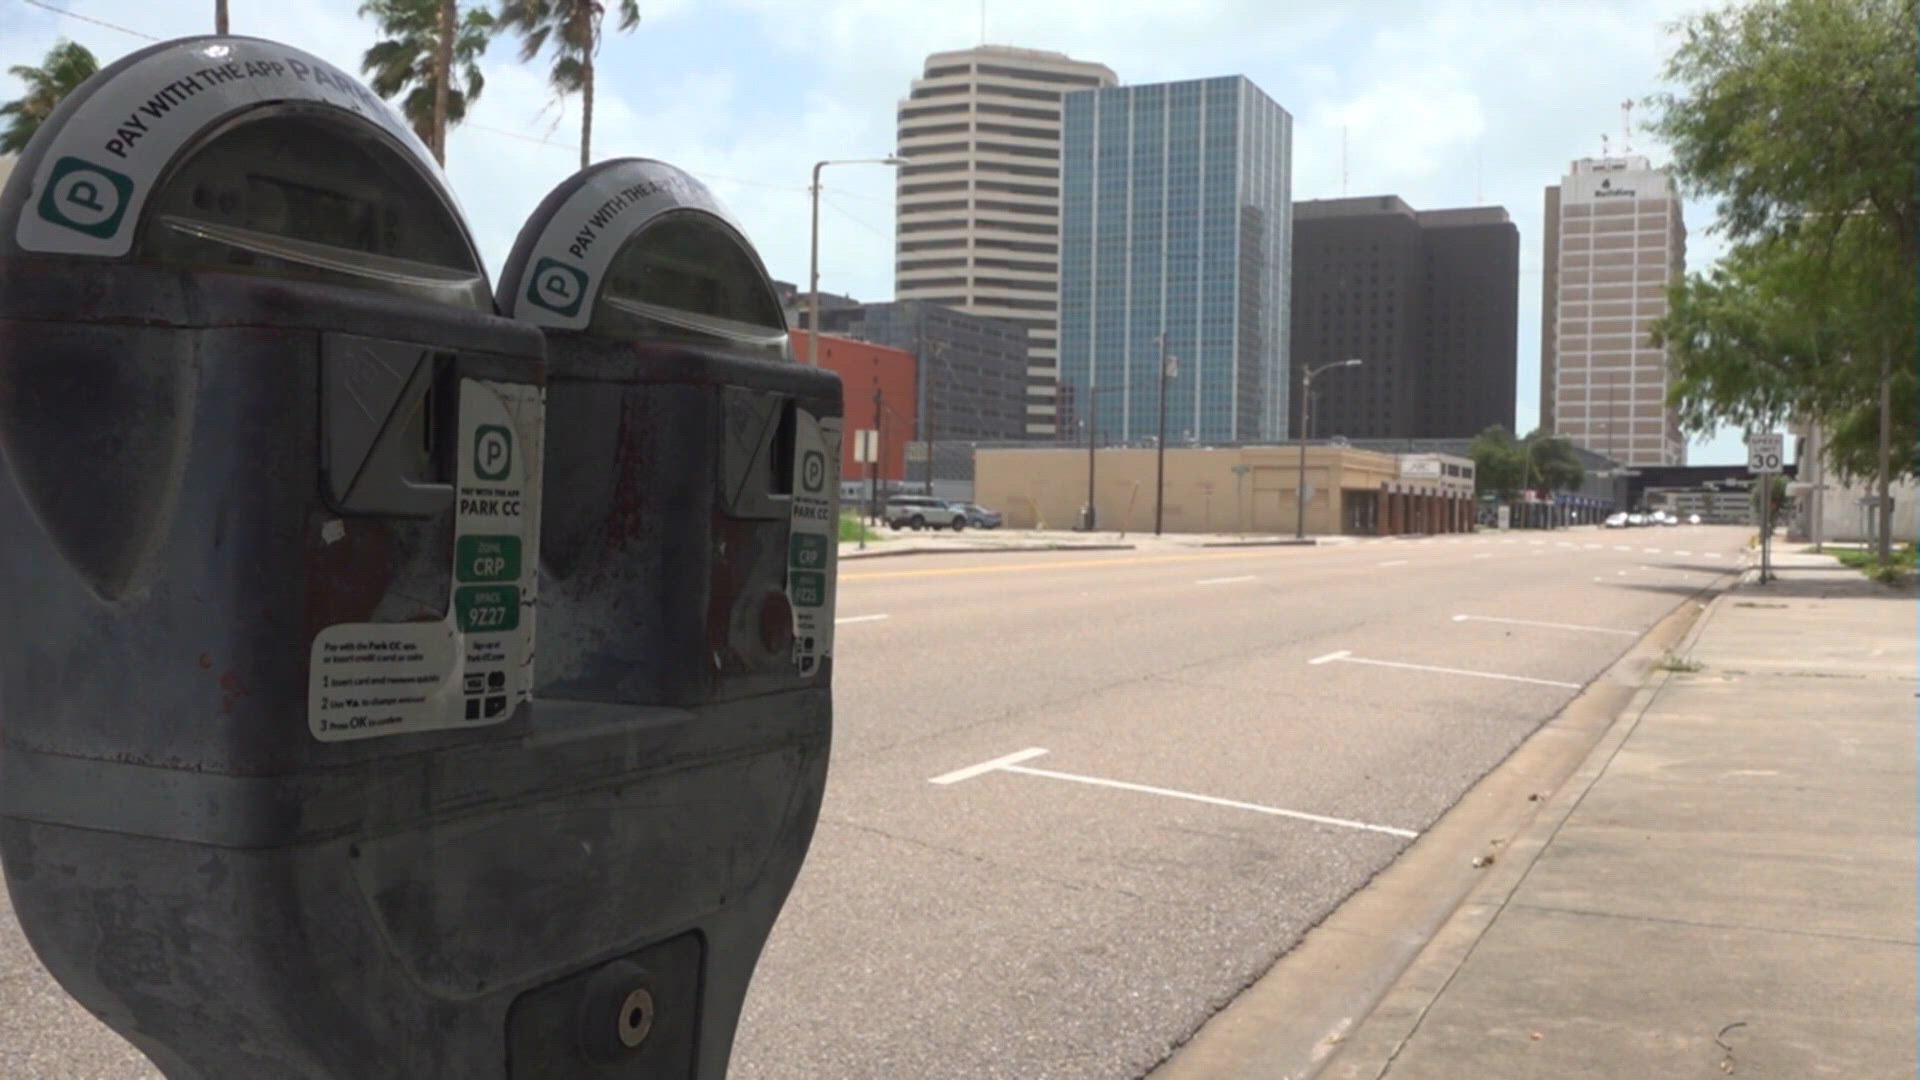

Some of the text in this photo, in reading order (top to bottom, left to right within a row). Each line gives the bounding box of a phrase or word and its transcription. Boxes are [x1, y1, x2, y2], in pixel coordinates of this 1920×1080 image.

[105, 61, 284, 159] PAY WITH THE APP
[66, 180, 104, 213] P
[1594, 188, 1636, 198] Building
[568, 225, 597, 259] PAY
[589, 195, 630, 229] WITH
[620, 183, 652, 203] THE
[545, 274, 571, 299] P
[486, 440, 501, 466] P
[1752, 454, 1779, 469] 30
[461, 499, 520, 517] PARK CC
[794, 504, 829, 521] PARK CC
[799, 549, 818, 565] CRP
[473, 557, 505, 576] CRP
[469, 606, 506, 627] 9Z27
[368, 640, 388, 651] Park
[388, 641, 401, 651] CC
[323, 675, 329, 688] 1
[321, 697, 328, 710] 2
[321, 719, 328, 732] 3
[349, 716, 368, 730] OK
